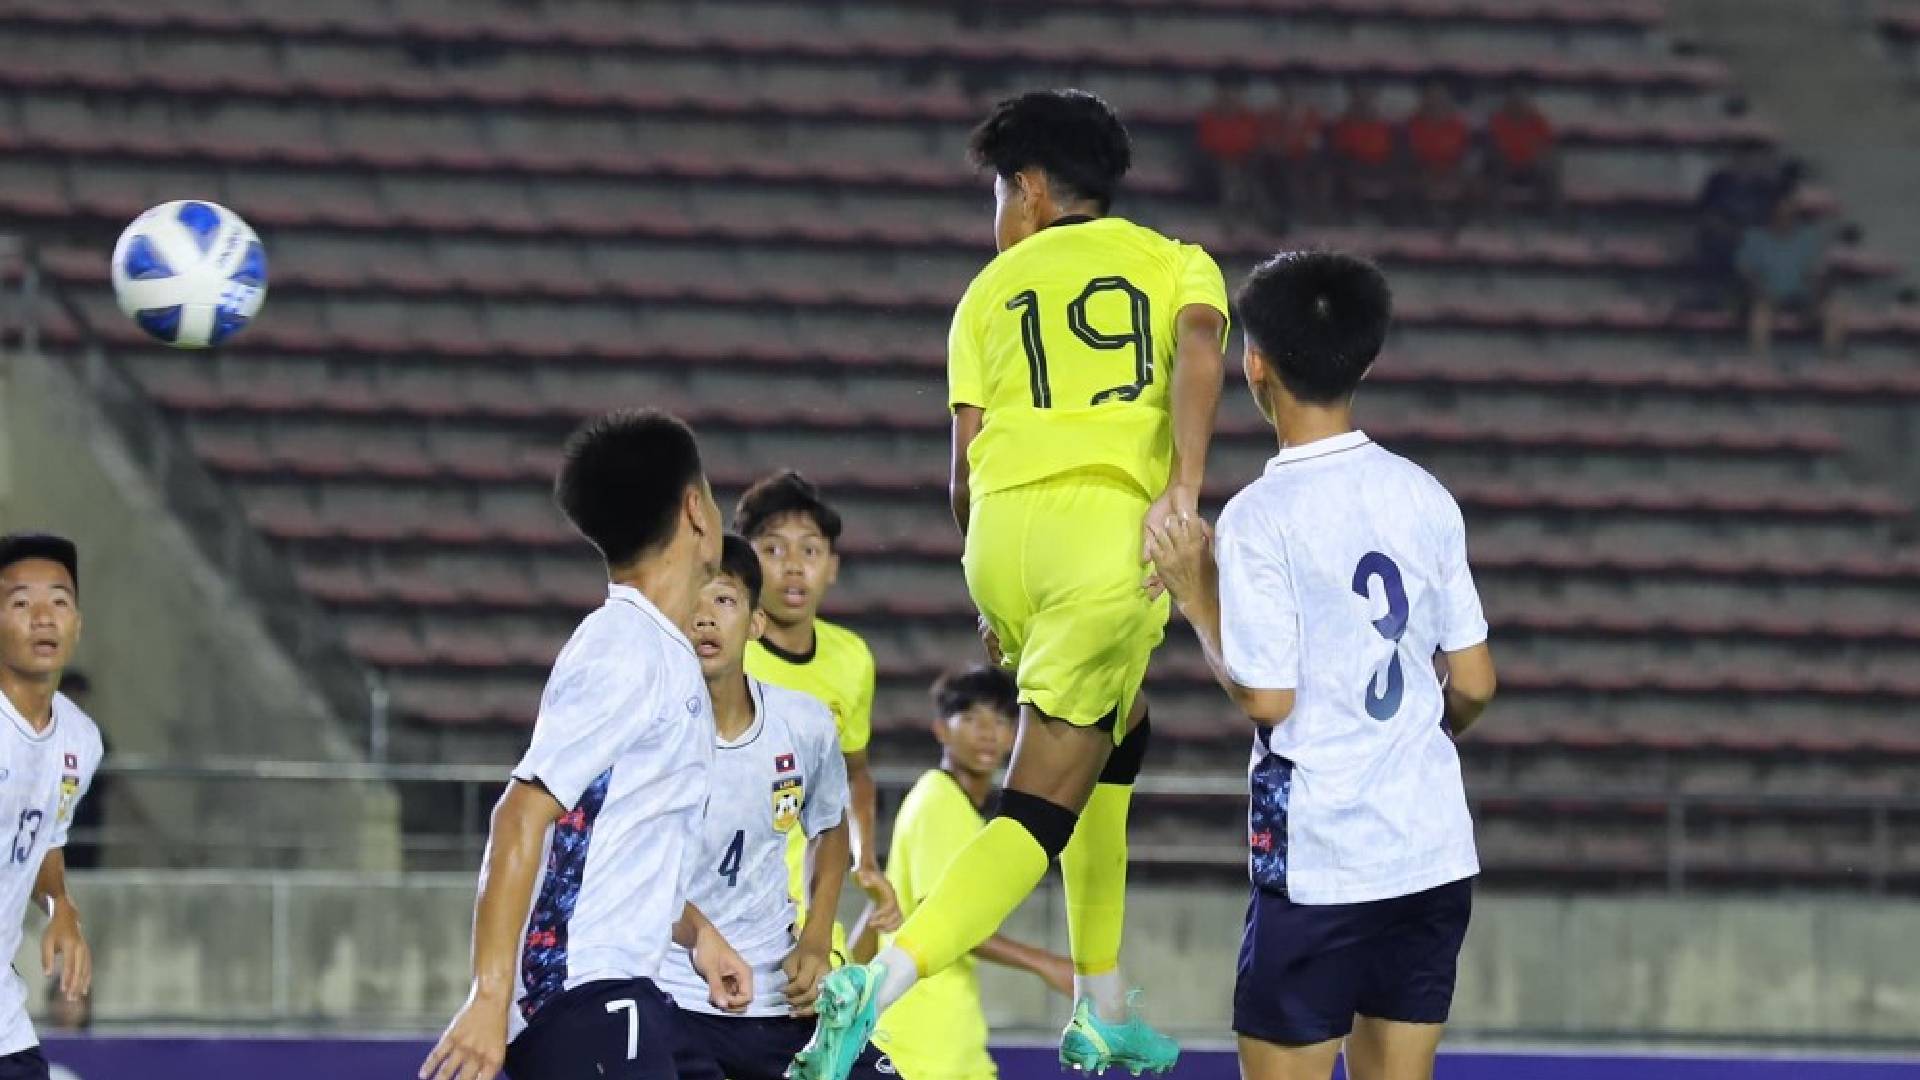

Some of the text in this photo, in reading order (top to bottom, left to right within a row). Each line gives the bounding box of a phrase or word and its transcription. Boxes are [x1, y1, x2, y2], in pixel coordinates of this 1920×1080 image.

[1006, 276, 1153, 408] 19
[1352, 551, 1409, 721] 3
[10, 808, 43, 864] 13
[718, 829, 745, 887] 4
[605, 1000, 638, 1060] 7
